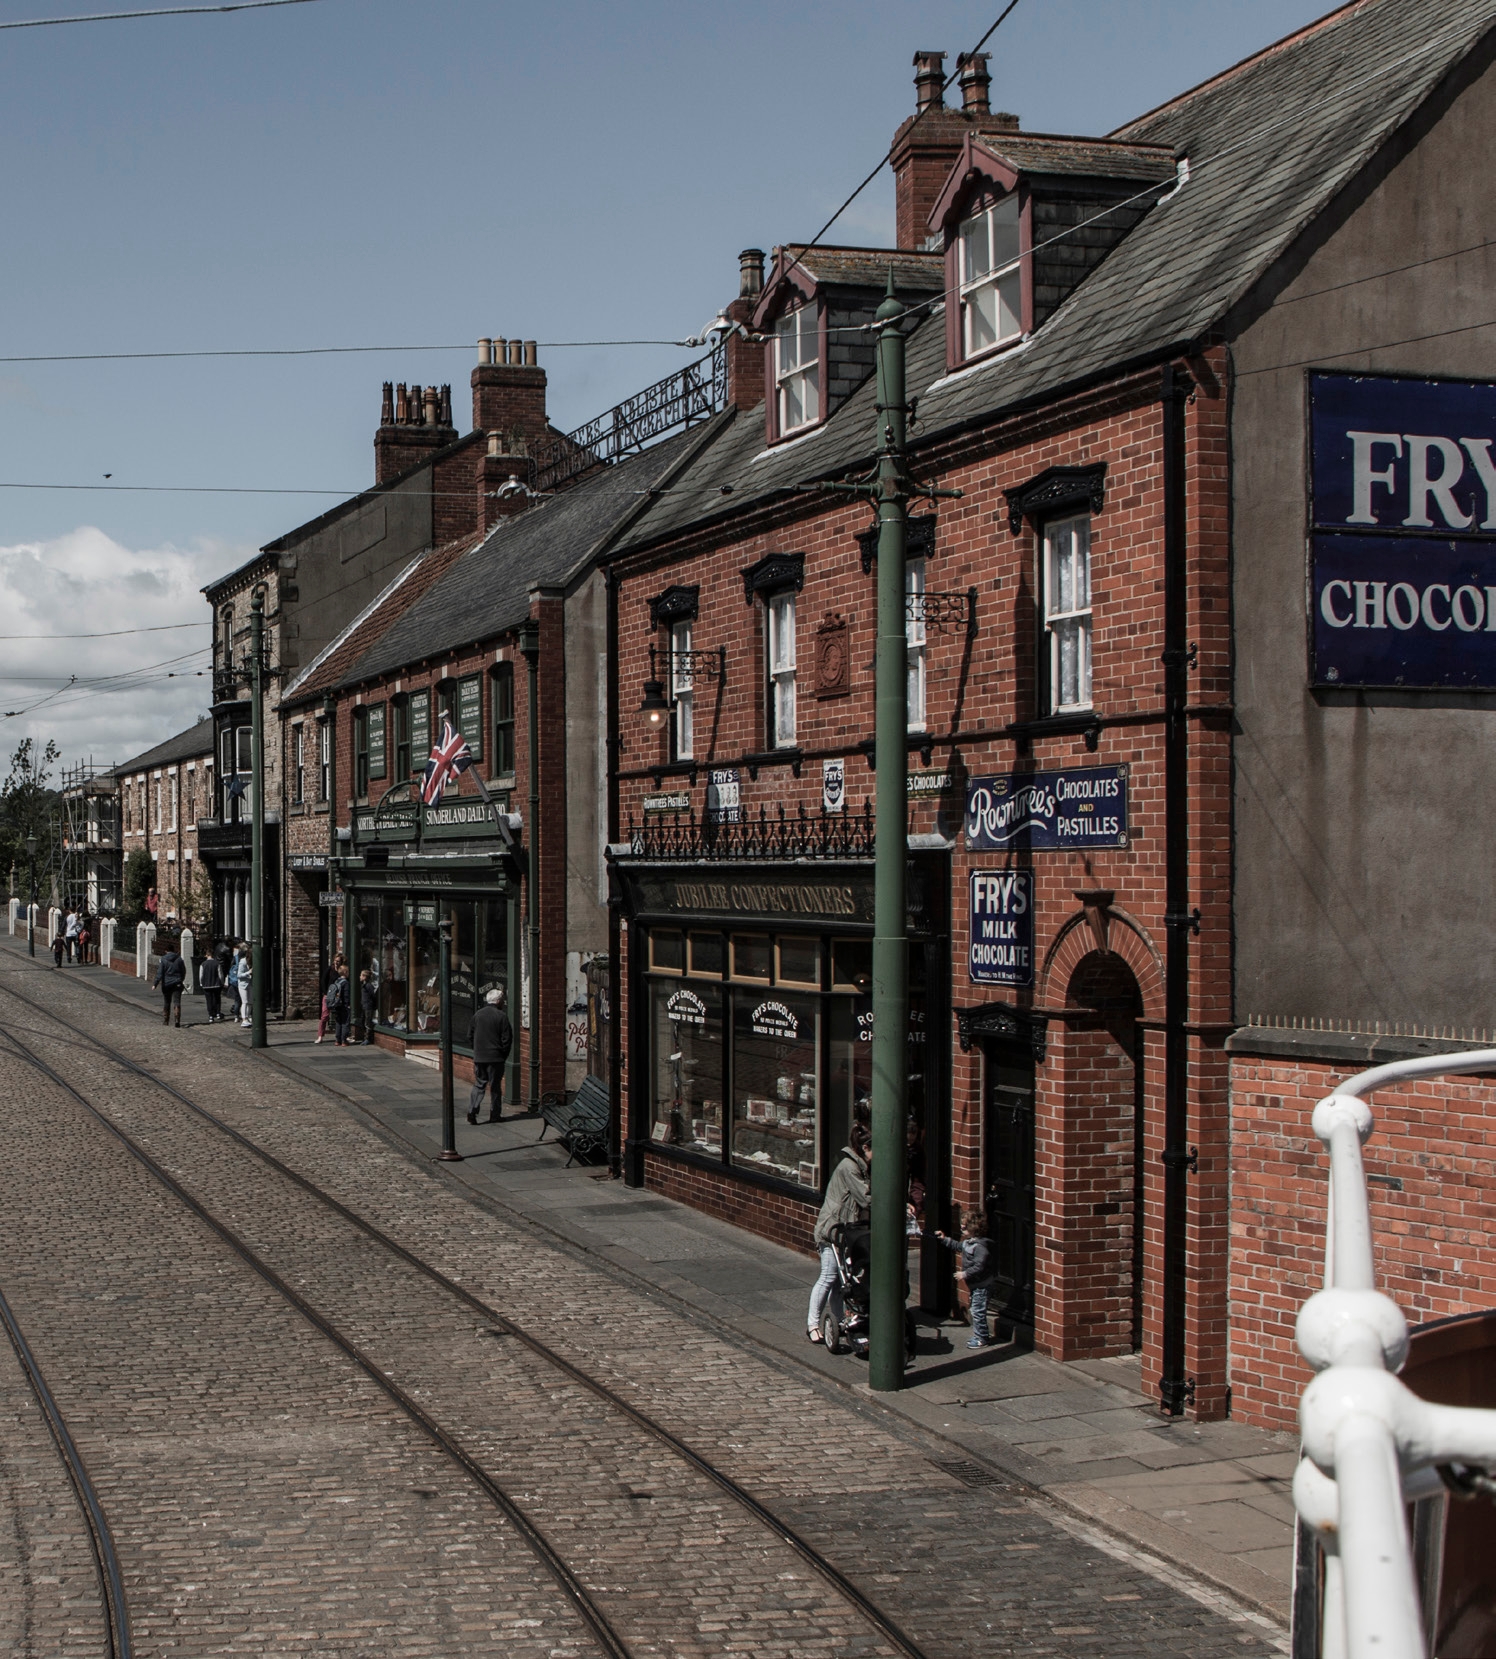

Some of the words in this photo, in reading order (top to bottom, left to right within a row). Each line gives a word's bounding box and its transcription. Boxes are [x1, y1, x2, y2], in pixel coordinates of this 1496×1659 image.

[914, 774, 952, 790] CHOCOLATES
[1056, 778, 1119, 801] CHOCOLATES
[667, 795, 689, 808] PASTILLES
[1078, 803, 1094, 812] AND
[426, 807, 466, 825] SUNDERLAND
[467, 805, 485, 822] DAILY
[968, 785, 1056, 842] Rowntree's
[1057, 816, 1119, 836] PASTILLES
[675, 883, 730, 910] JUBILEE
[731, 885, 856, 915] CONFECTIONERS
[974, 872, 1027, 915] FRY'S
[982, 920, 1018, 939] MILK
[971, 942, 1029, 967] CHOCOLATE
[667, 991, 680, 1010] FRY'S
[680, 989, 707, 1016] CHOCOLATE
[752, 1003, 767, 1022] FRY'S
[767, 1001, 799, 1030] CHOCOLATE
[753, 1025, 768, 1034] MAKERS
[768, 1027, 774, 1035] TO
[775, 1028, 783, 1037] THE
[783, 1029, 798, 1039] QUEEN
